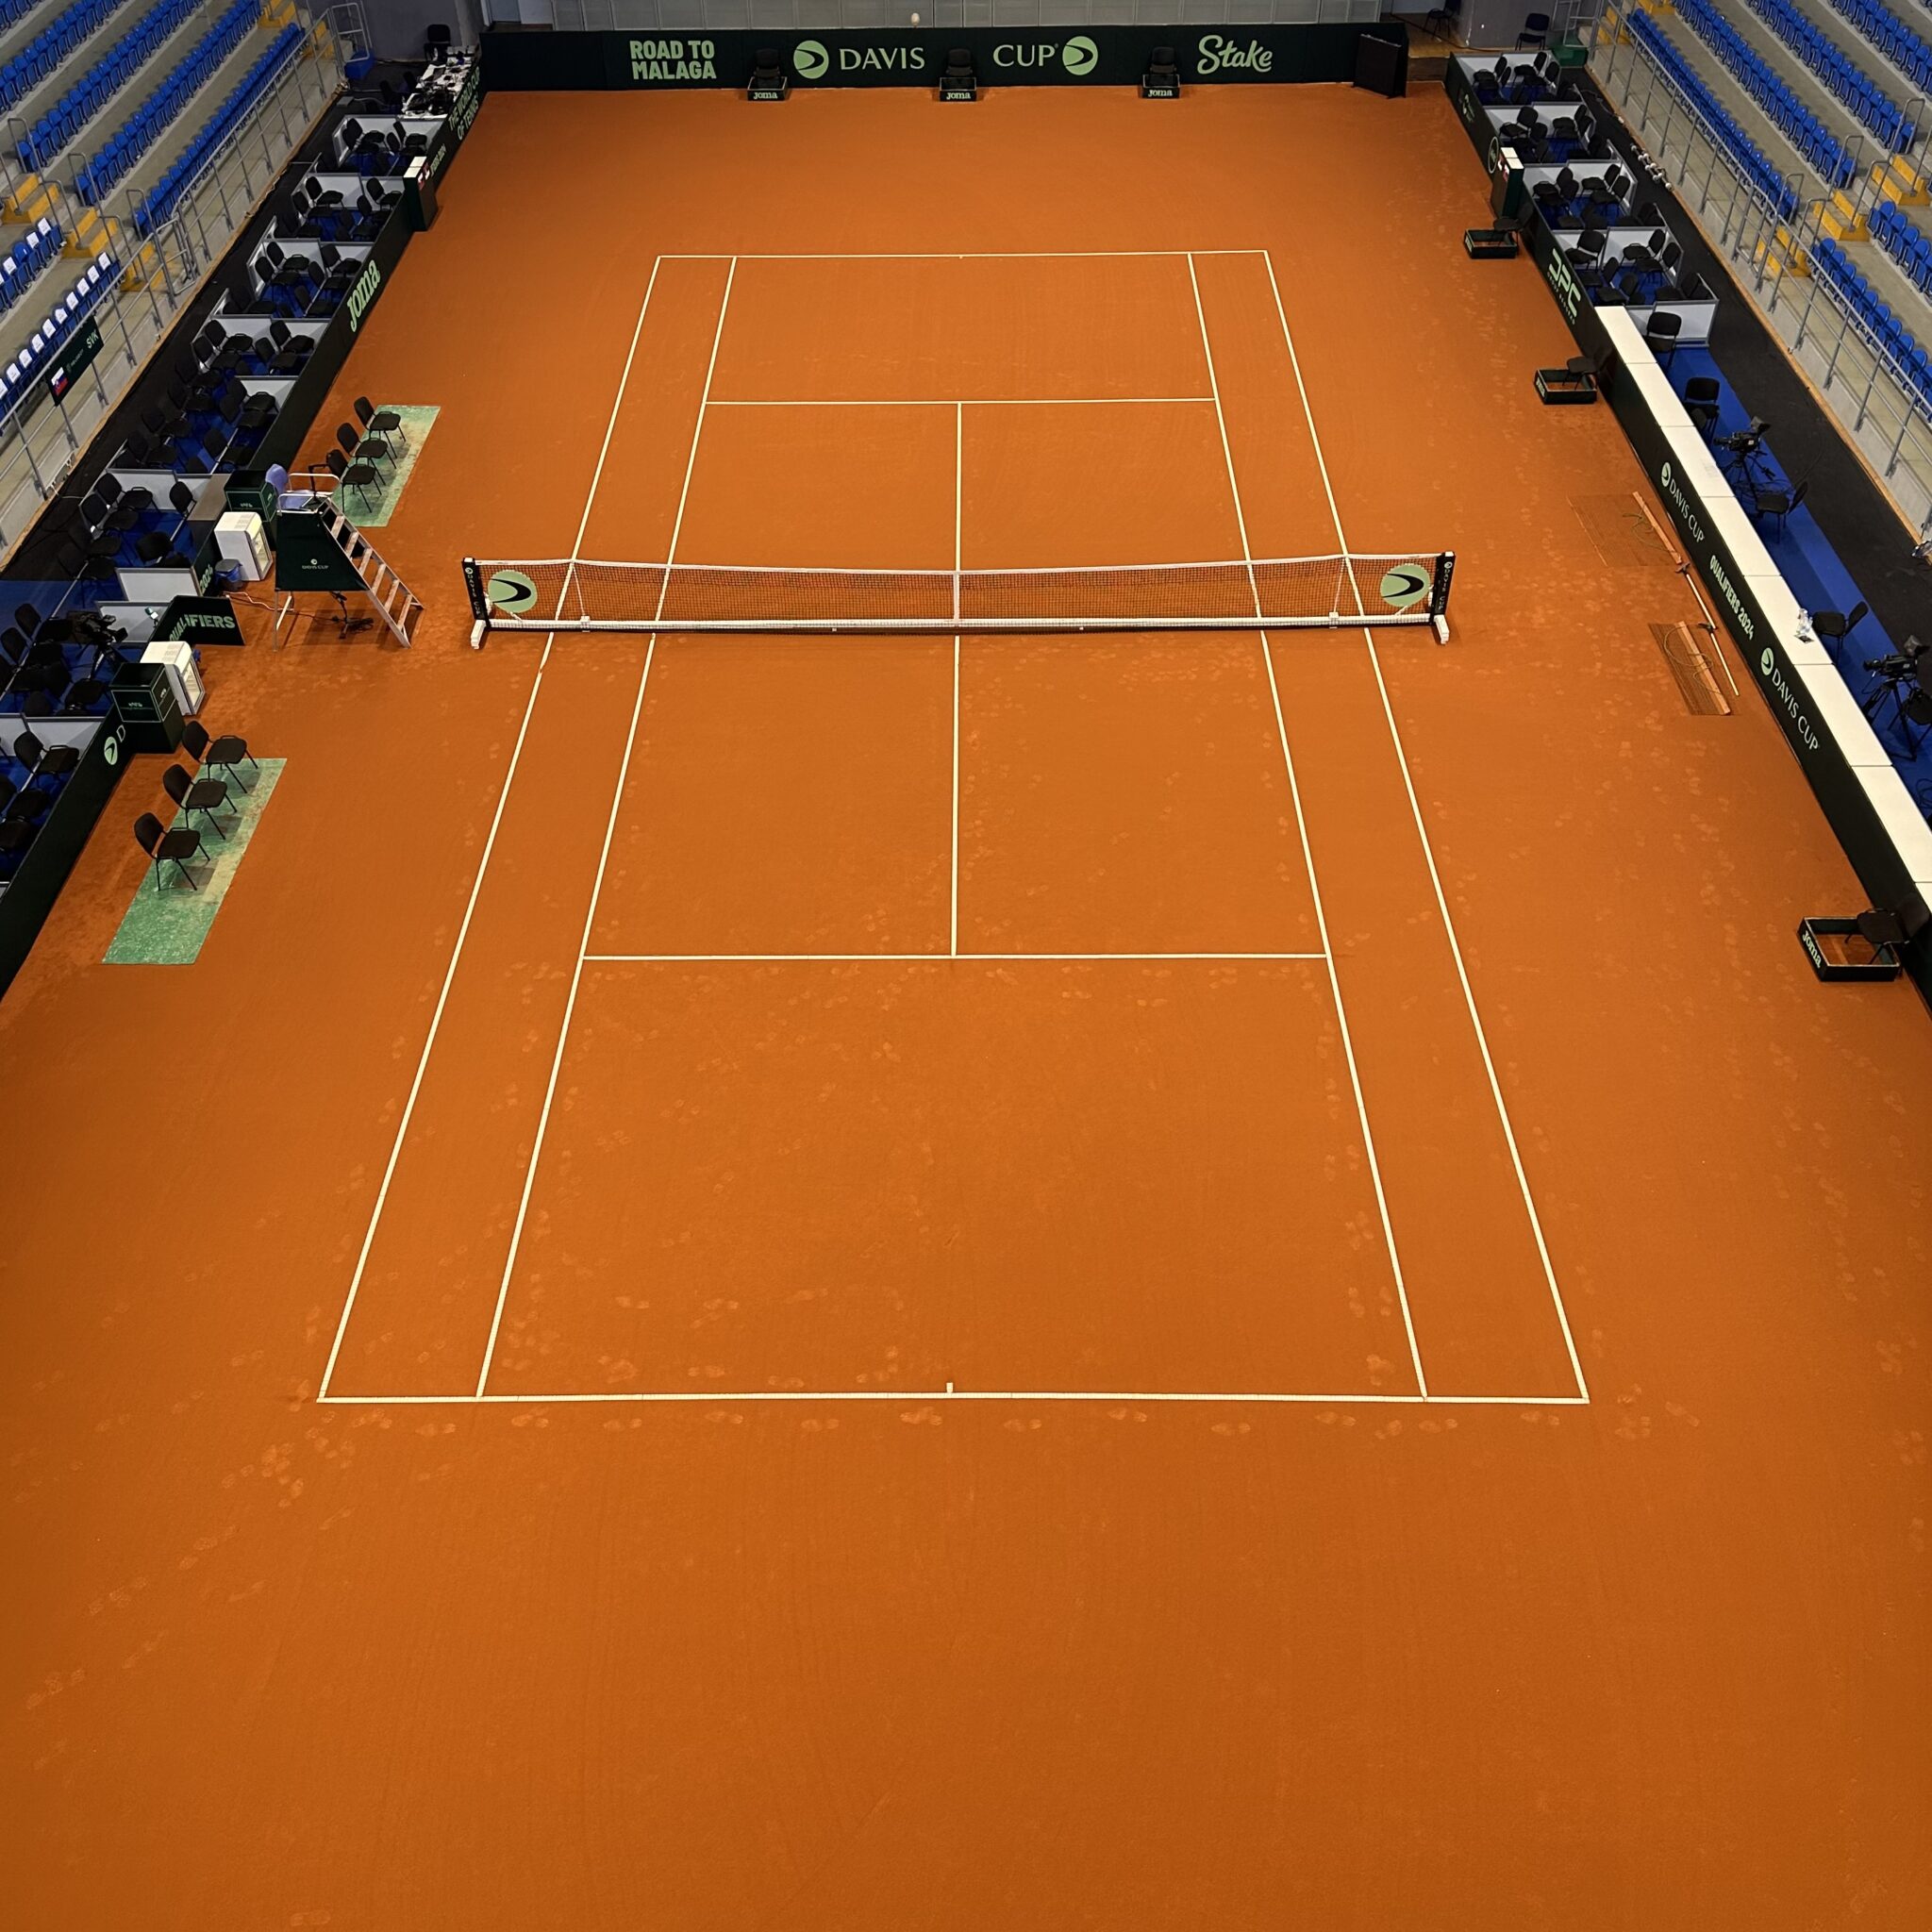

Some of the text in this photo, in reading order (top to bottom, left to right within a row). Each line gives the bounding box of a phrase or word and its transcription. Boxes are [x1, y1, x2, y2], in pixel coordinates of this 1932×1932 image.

[629, 40, 715, 59] ROAD TO
[631, 60, 717, 80] MALAGA
[839, 47, 925, 70] DAVIS
[1196, 34, 1273, 75] Stake
[1669, 478, 1705, 543] DAVIS CUP
[1709, 554, 1754, 641] QUALIFIERS 2024
[1772, 668, 1818, 750] DAVIS CUP
